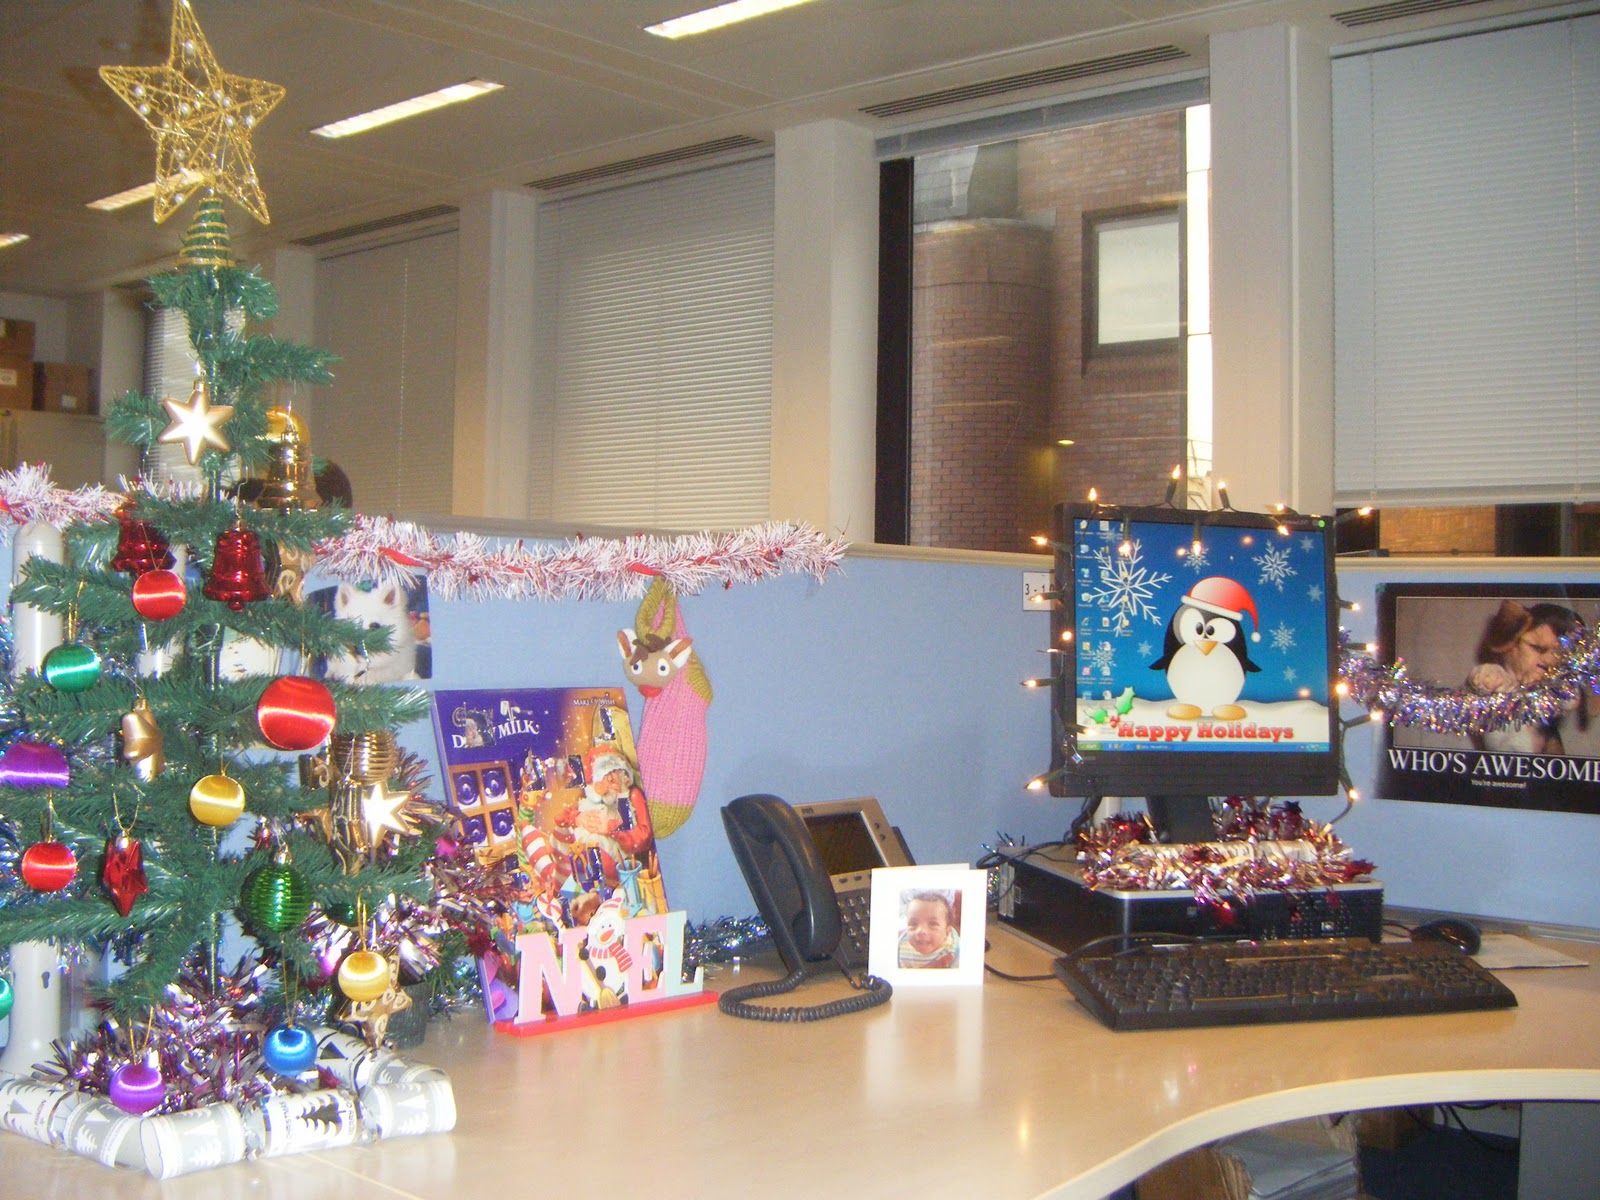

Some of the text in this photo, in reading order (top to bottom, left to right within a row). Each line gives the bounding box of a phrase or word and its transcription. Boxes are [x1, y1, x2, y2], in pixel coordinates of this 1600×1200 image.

[498, 719, 539, 738] MILK
[1117, 721, 1294, 742] Happy Holidays
[1388, 750, 1467, 774] WHO'S
[1471, 779, 1491, 787] You're
[514, 910, 704, 1024] NEL
